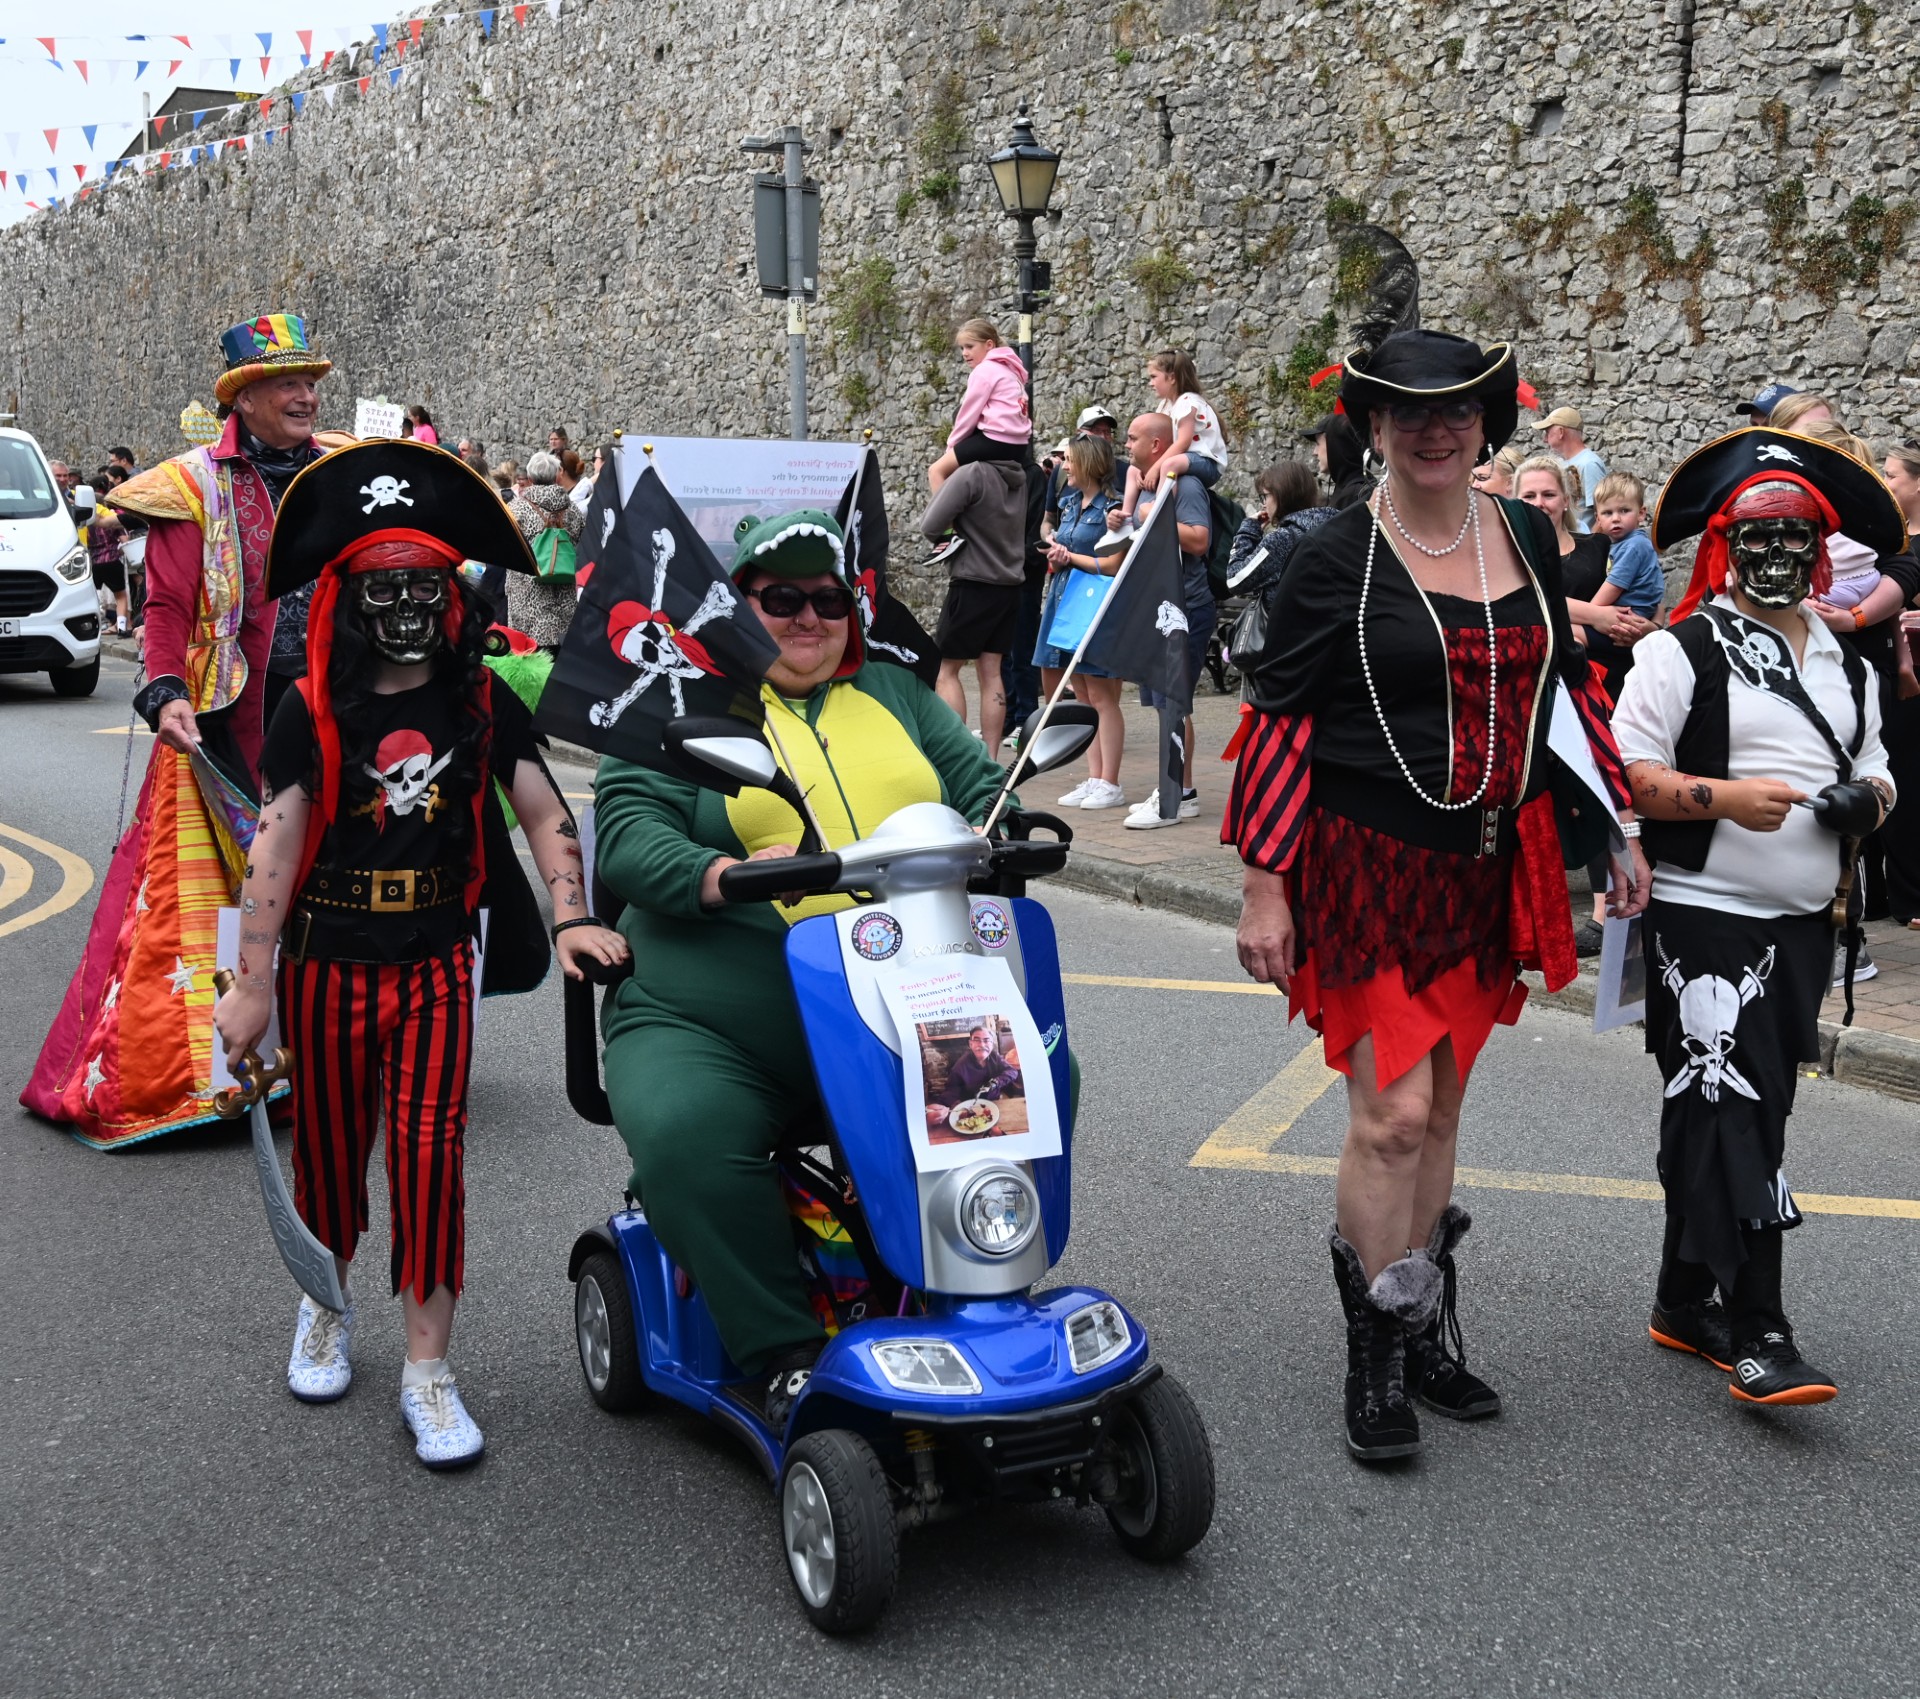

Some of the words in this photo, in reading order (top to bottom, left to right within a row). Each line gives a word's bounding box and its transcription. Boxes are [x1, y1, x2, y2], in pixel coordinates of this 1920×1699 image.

[365, 407, 396, 418] STEAM
[367, 417, 393, 428] PUNK
[363, 425, 399, 438] QUEENS
